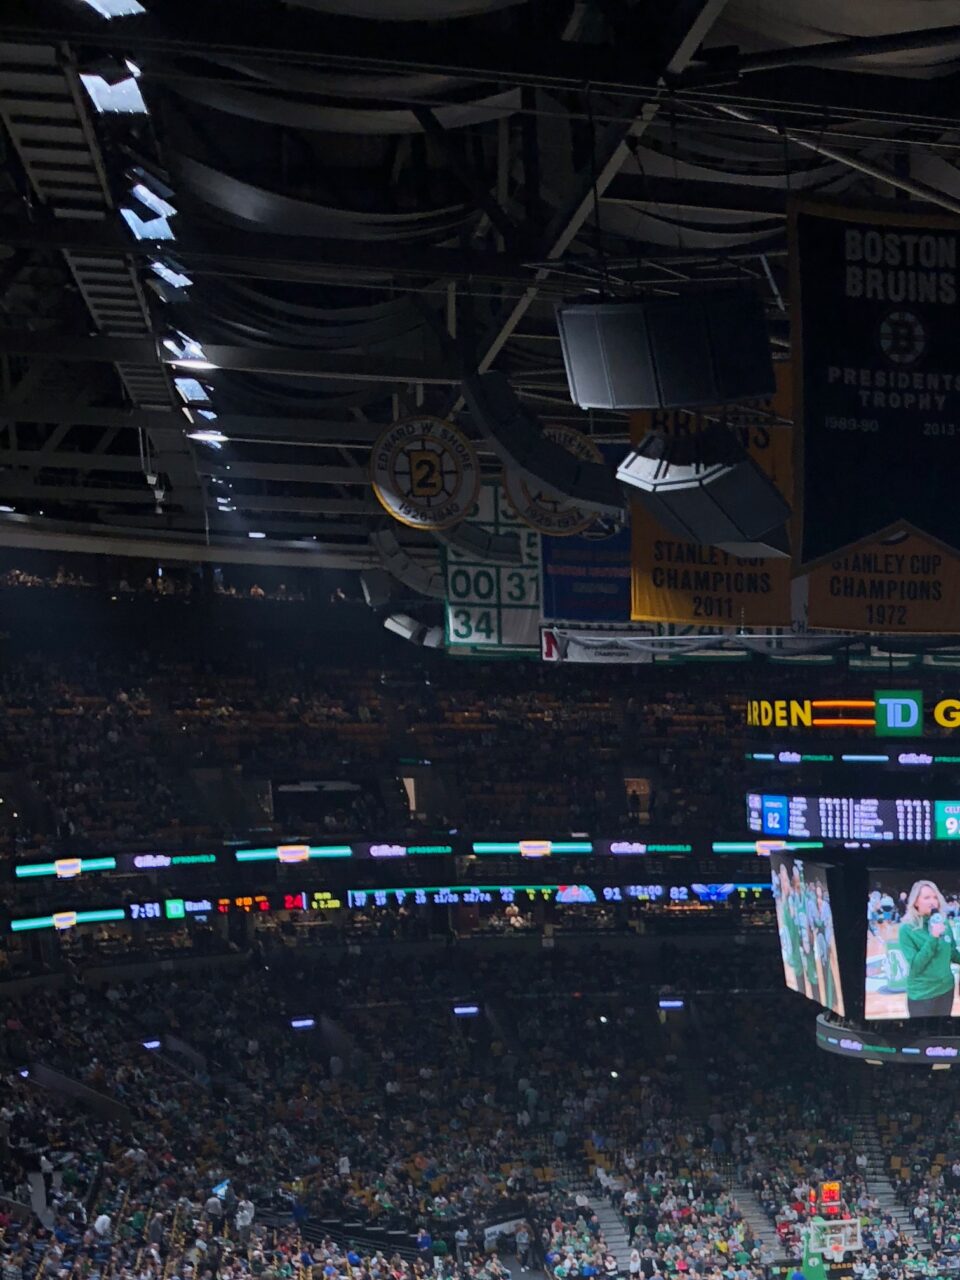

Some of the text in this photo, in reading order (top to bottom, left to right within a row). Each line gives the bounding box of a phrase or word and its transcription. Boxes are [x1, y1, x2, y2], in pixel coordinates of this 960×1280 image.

[844, 228, 957, 269] BOSTON
[845, 265, 957, 304] BRUINS
[858, 389, 946, 411] TROPHY
[377, 423, 416, 471] EDWARD
[440, 426, 473, 471] SHORE
[414, 459, 436, 488] 2
[654, 540, 729, 565] STANLEY
[832, 553, 941, 574] STANLEY CUP
[450, 569, 495, 600] 00
[652, 568, 771, 593] CHAMPIONS
[829, 575, 942, 601] CHAMPIONS
[693, 595, 733, 618] 2011
[864, 603, 907, 626] 1972
[453, 609, 495, 640] 34
[879, 698, 919, 728] TD
[602, 886, 622, 900] 91
[669, 886, 688, 900] 82
[130, 902, 161, 918] 7:51
